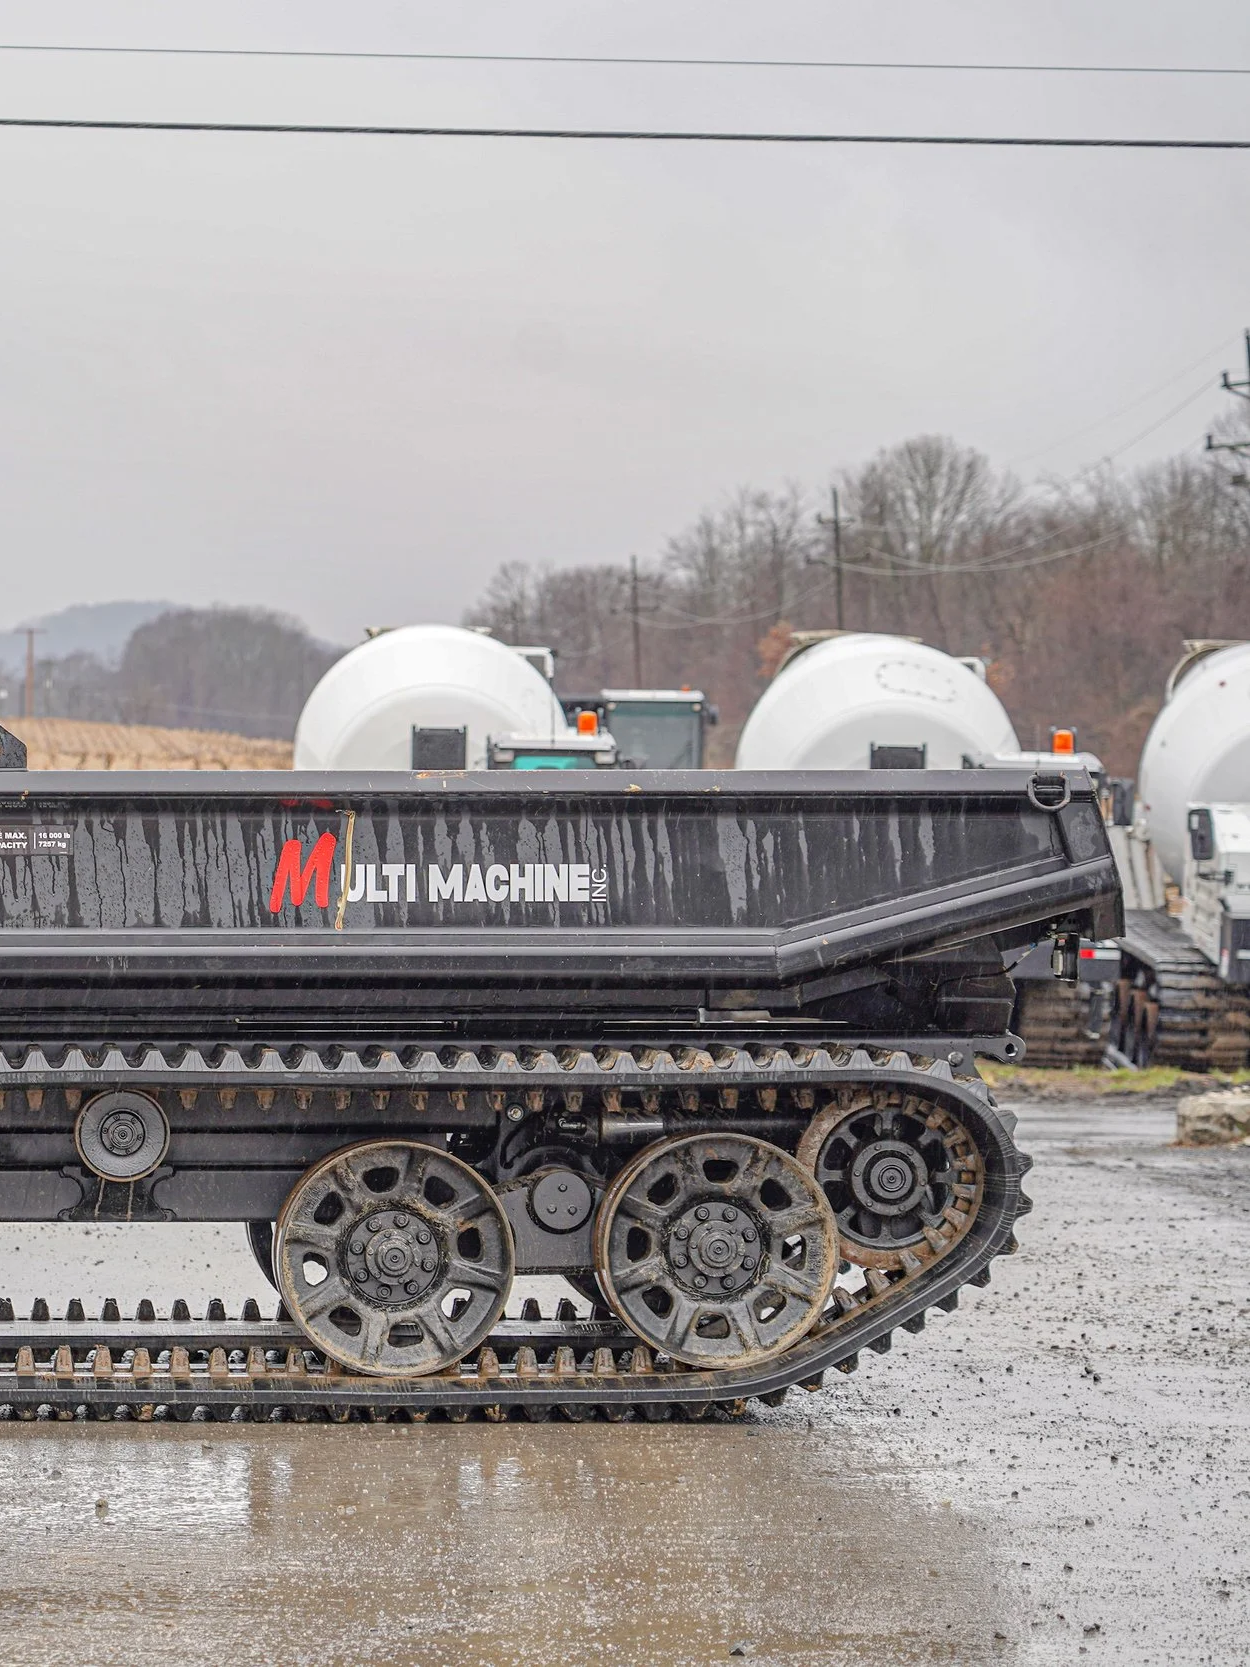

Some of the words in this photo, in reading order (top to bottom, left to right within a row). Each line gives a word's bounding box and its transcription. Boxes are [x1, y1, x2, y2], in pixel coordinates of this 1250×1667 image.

[57, 841, 67, 849] kg
[428, 864, 590, 902] MACHINE
[591, 863, 607, 902] INC.
